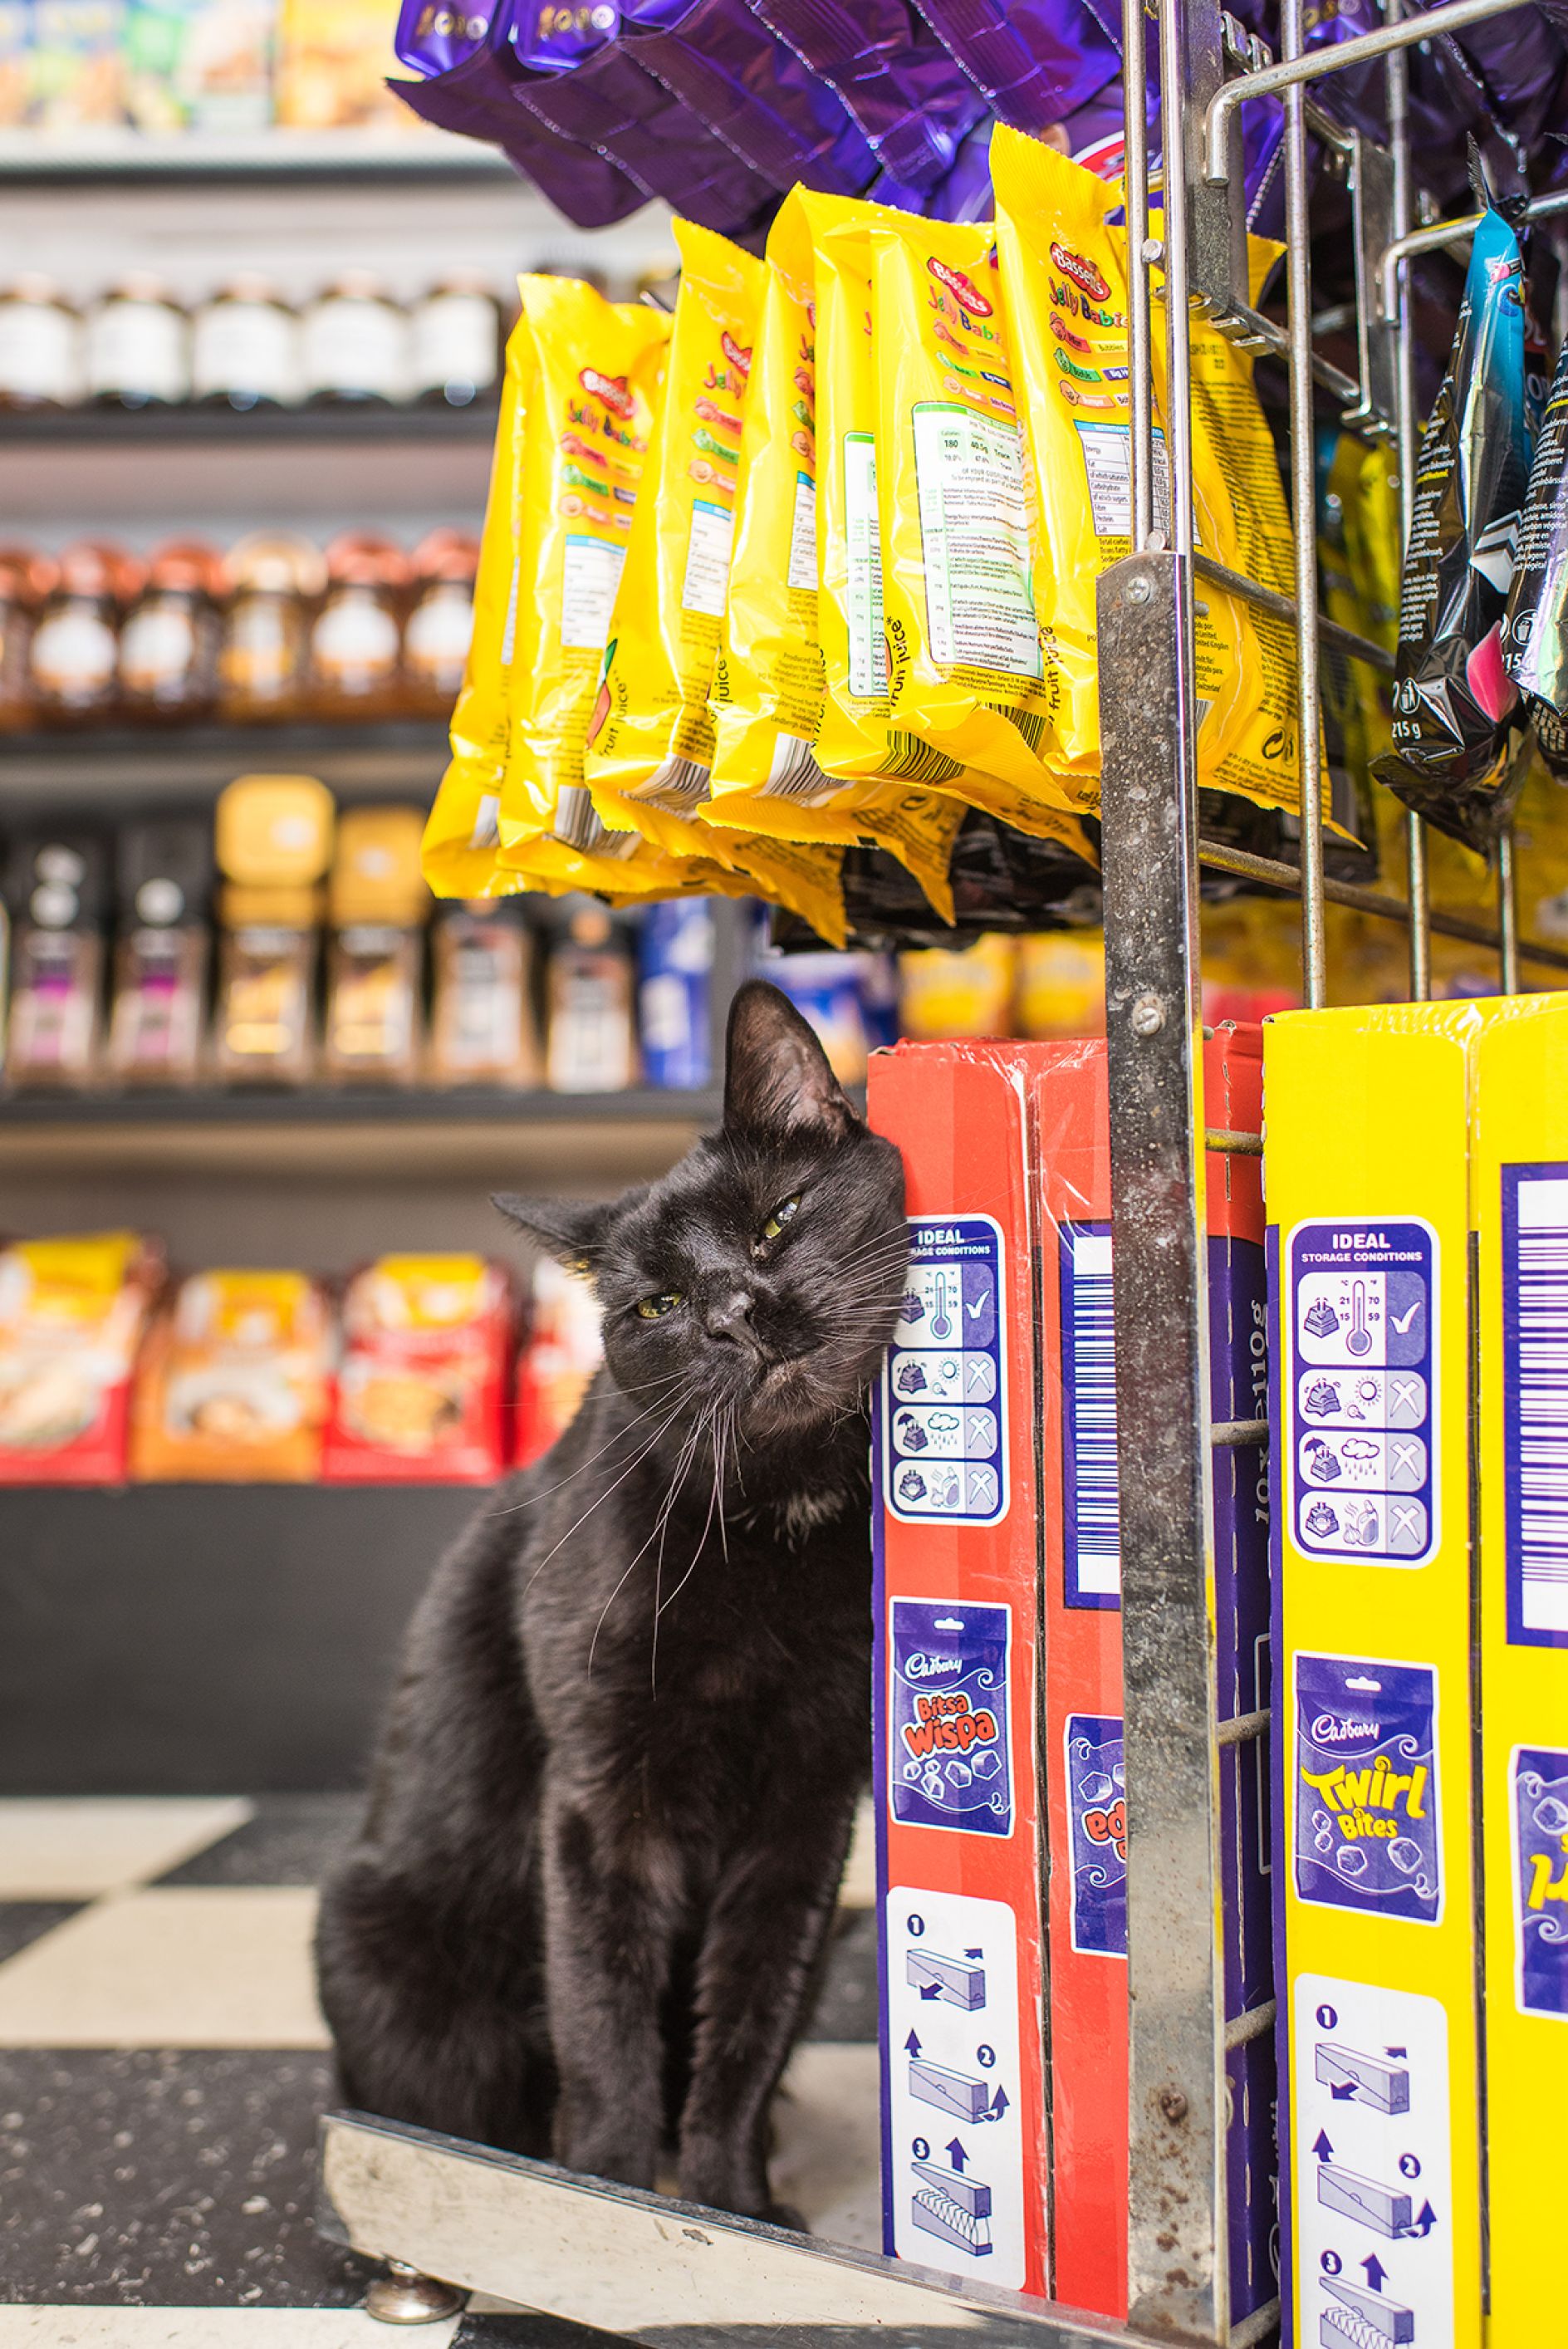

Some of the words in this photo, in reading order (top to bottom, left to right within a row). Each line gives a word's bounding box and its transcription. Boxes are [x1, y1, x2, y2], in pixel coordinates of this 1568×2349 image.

[928, 285, 958, 324] Jelly
[959, 308, 1001, 346] Babi
[1049, 277, 1079, 316] Jelly
[1080, 294, 1129, 328] Babie
[944, 439, 958, 449] 180
[715, 660, 733, 704] juice
[890, 668, 906, 707] fruit
[1047, 669, 1061, 710] fruit
[1391, 722, 1411, 738] 215
[1412, 723, 1422, 740] g
[918, 1229, 965, 1244] IDEAL
[1332, 1233, 1391, 1249] IDEAL
[936, 1246, 991, 1256] CONDITIONS
[1301, 1253, 1351, 1263] STORAGE
[1353, 1252, 1423, 1263] CONDITIONS
[1340, 1297, 1350, 1305] 21
[1368, 1297, 1380, 1305] 70
[1340, 1313, 1350, 1322] 15
[1368, 1312, 1380, 1322] 59
[905, 1652, 962, 1679] Cadbury
[917, 1694, 968, 1722] Bitsa
[904, 1711, 996, 1758] Wispa
[1311, 1714, 1380, 1743] Cadbury
[1301, 1755, 1428, 1819] Twirl
[1337, 1808, 1399, 1841] Bites
